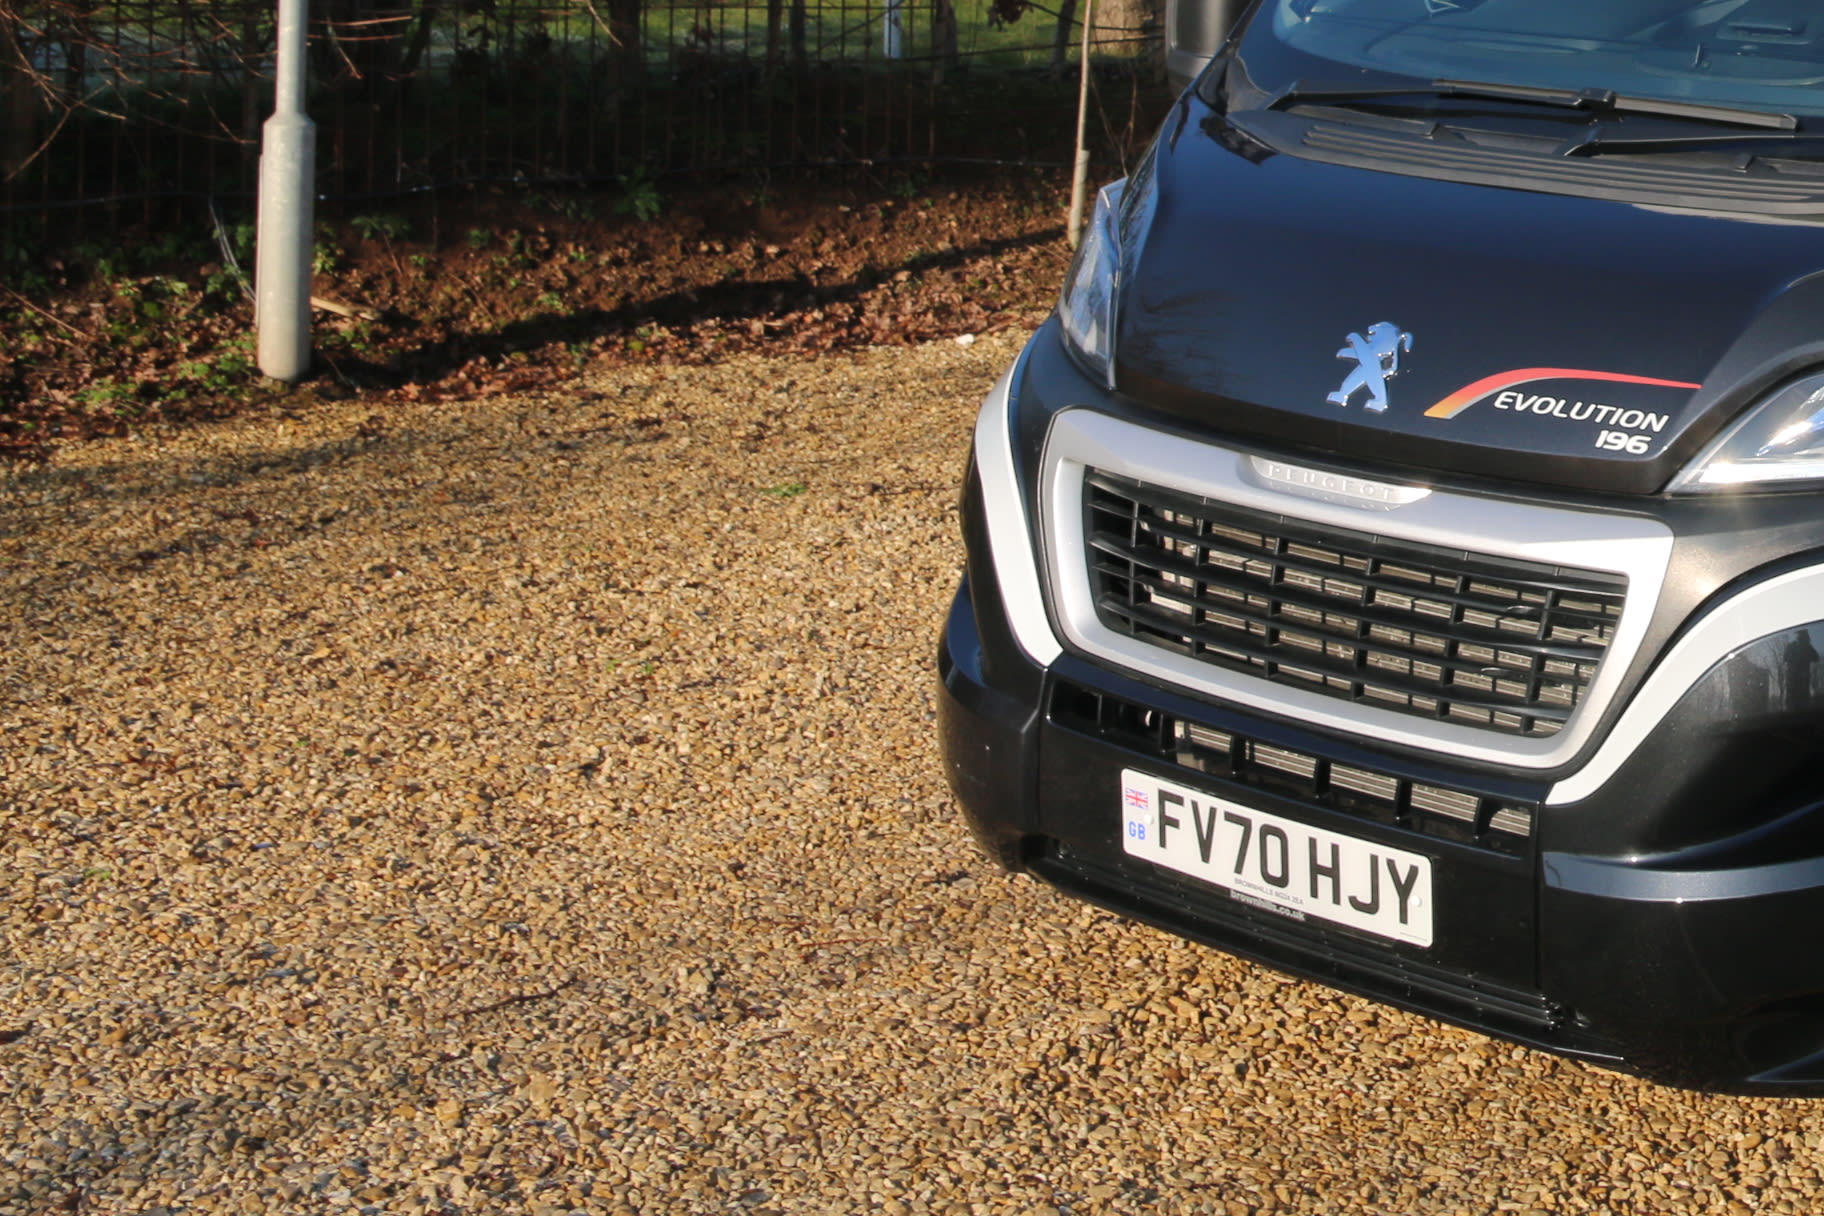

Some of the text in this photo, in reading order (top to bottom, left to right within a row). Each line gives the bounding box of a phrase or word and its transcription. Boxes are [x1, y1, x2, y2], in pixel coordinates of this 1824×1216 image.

[1494, 391, 1669, 433] EVOLUTION
[1595, 430, 1652, 455] 196
[1268, 464, 1396, 501] PEUGEOT
[1128, 821, 1146, 840] GB
[1158, 789, 1419, 924] FV70 HJY
